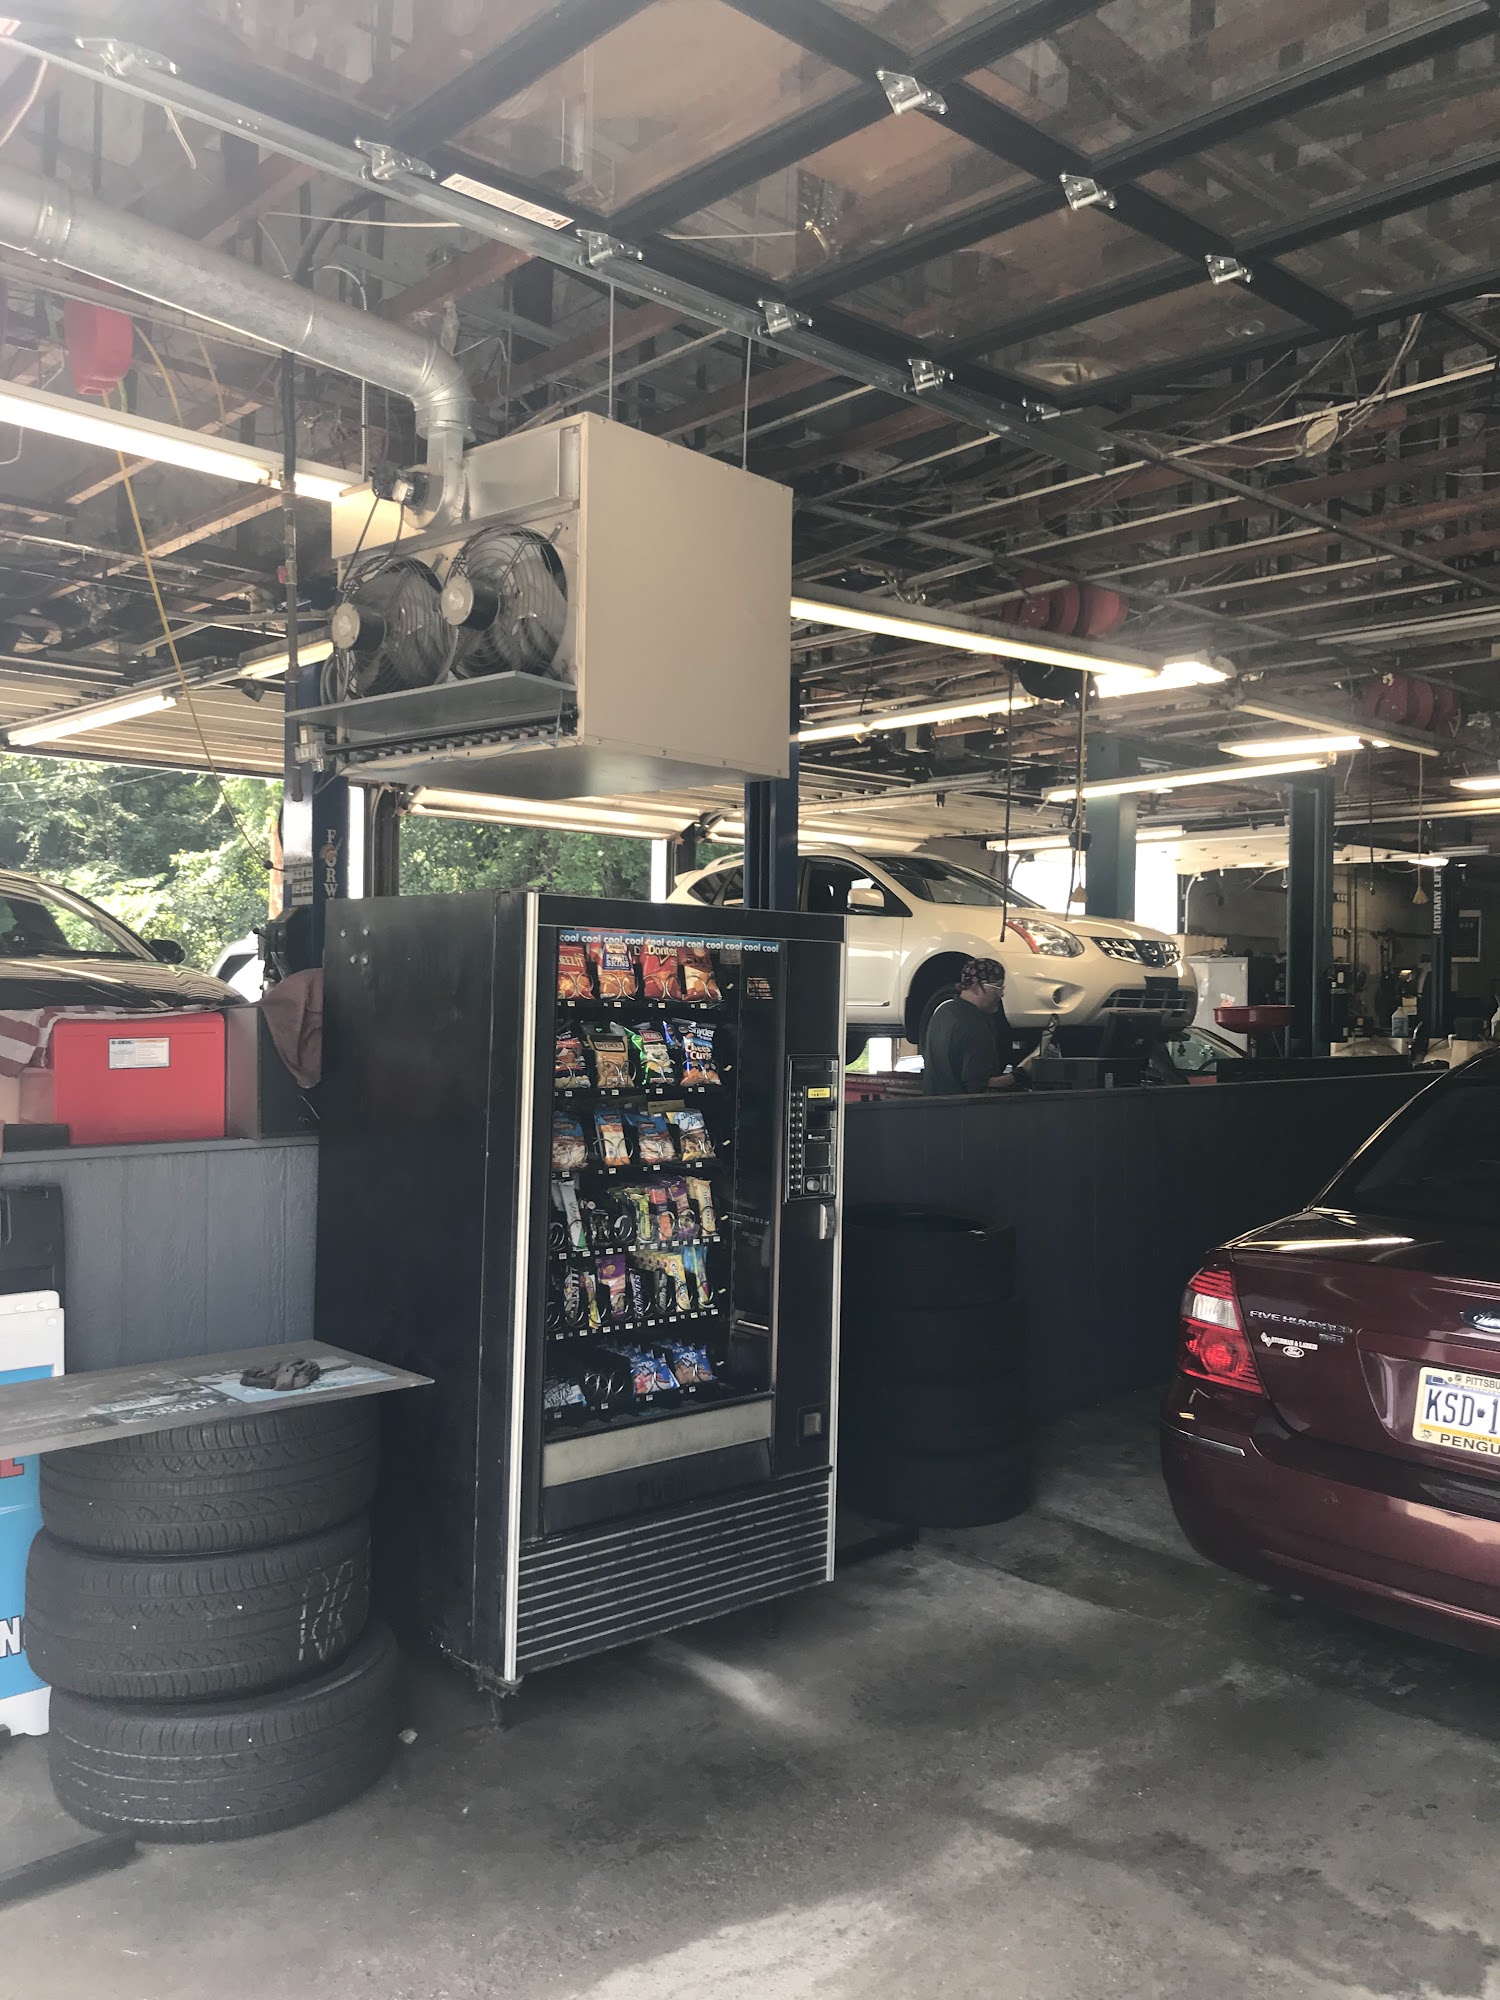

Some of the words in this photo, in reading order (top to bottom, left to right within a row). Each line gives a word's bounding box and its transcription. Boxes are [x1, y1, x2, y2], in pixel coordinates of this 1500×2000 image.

[323, 829, 338, 899] FORW
[560, 934, 579, 942] cool
[581, 935, 601, 943] cool
[603, 936, 623, 944] cool
[625, 937, 643, 945] cool
[646, 938, 665, 946] cool
[666, 939, 685, 947] cool
[687, 940, 704, 948] cool
[706, 941, 723, 949] cool
[725, 942, 742, 950] cool
[744, 943, 760, 951] cool
[762, 944, 779, 952] cool
[648, 944, 677, 956] Doritos
[605, 960, 630, 968] SKINS
[1250, 1310, 1281, 1322] FIVE
[1465, 1376, 1500, 1390] PITTSBU
[1440, 1433, 1500, 1455] PENGU
[0, 1615, 26, 1658] N
